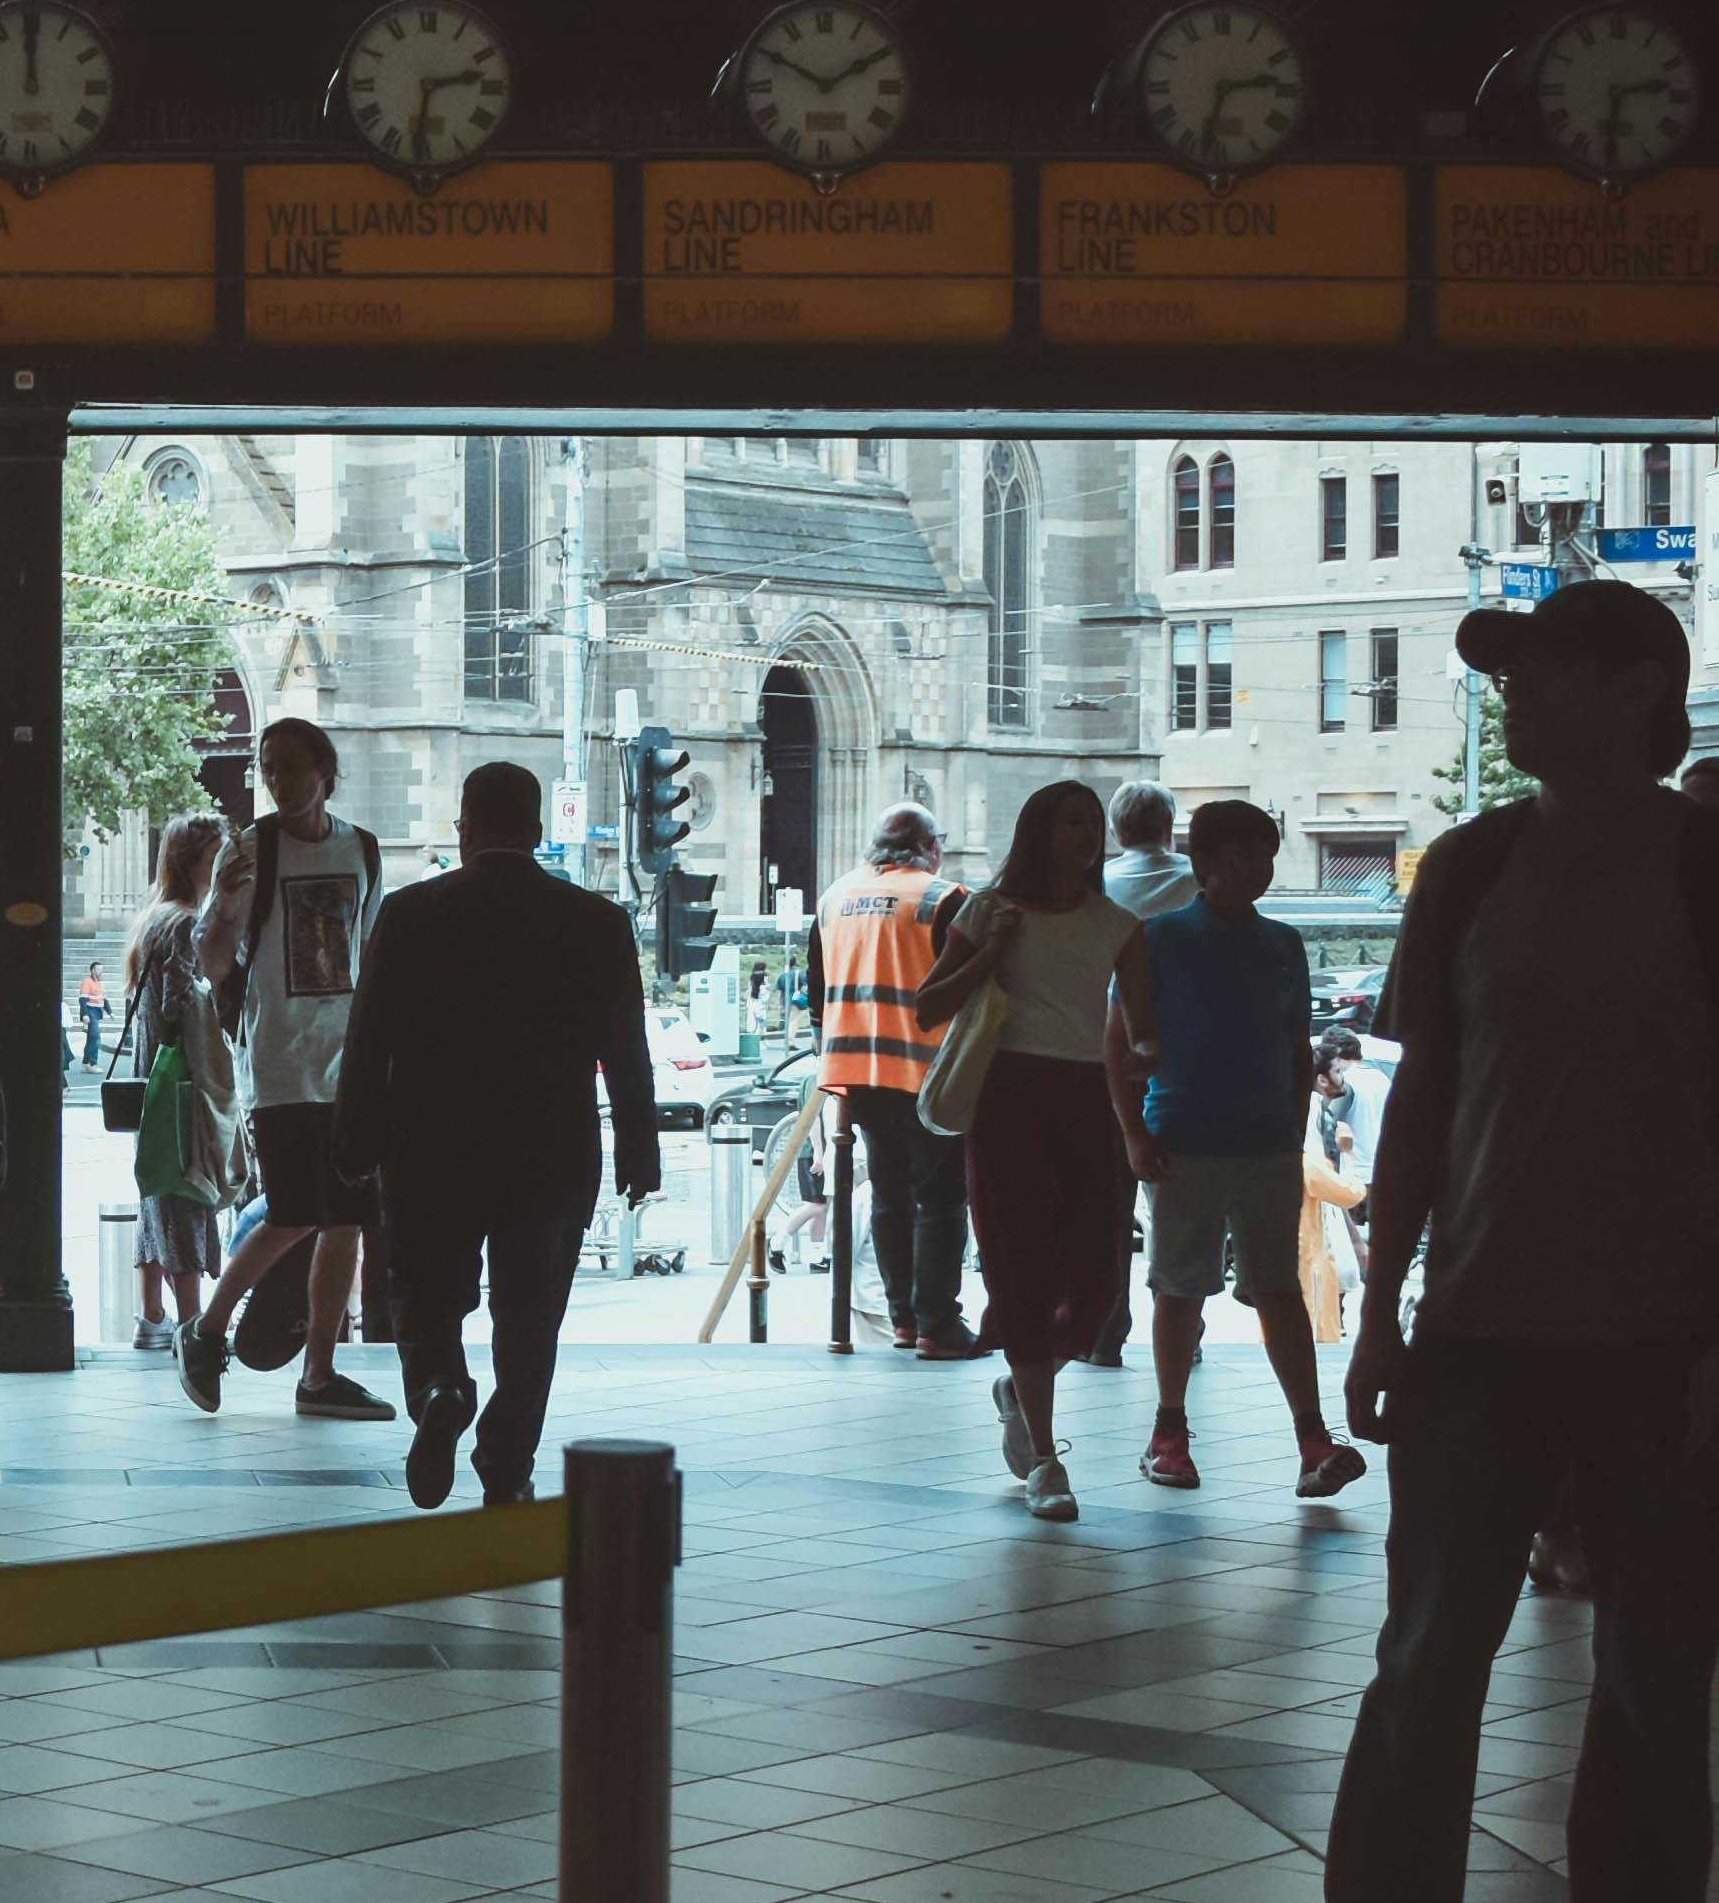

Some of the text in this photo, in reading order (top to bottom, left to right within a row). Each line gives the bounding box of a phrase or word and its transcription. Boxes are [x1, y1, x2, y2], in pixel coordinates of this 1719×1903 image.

[265, 200, 550, 237] WILLIAMSTOWN
[664, 199, 935, 235] SANDRINGHAM
[1057, 200, 1276, 236] FRANKSTON
[1451, 203, 1700, 241] PAKENHAM and
[264, 239, 343, 275] LINE
[663, 237, 743, 272] LINE
[1057, 238, 1136, 273] LINE
[1450, 240, 1676, 278] CRANBOURNE
[264, 301, 403, 327] PLATFORM
[663, 300, 802, 326] PLATFORM
[1057, 300, 1196, 327] PLATFORM
